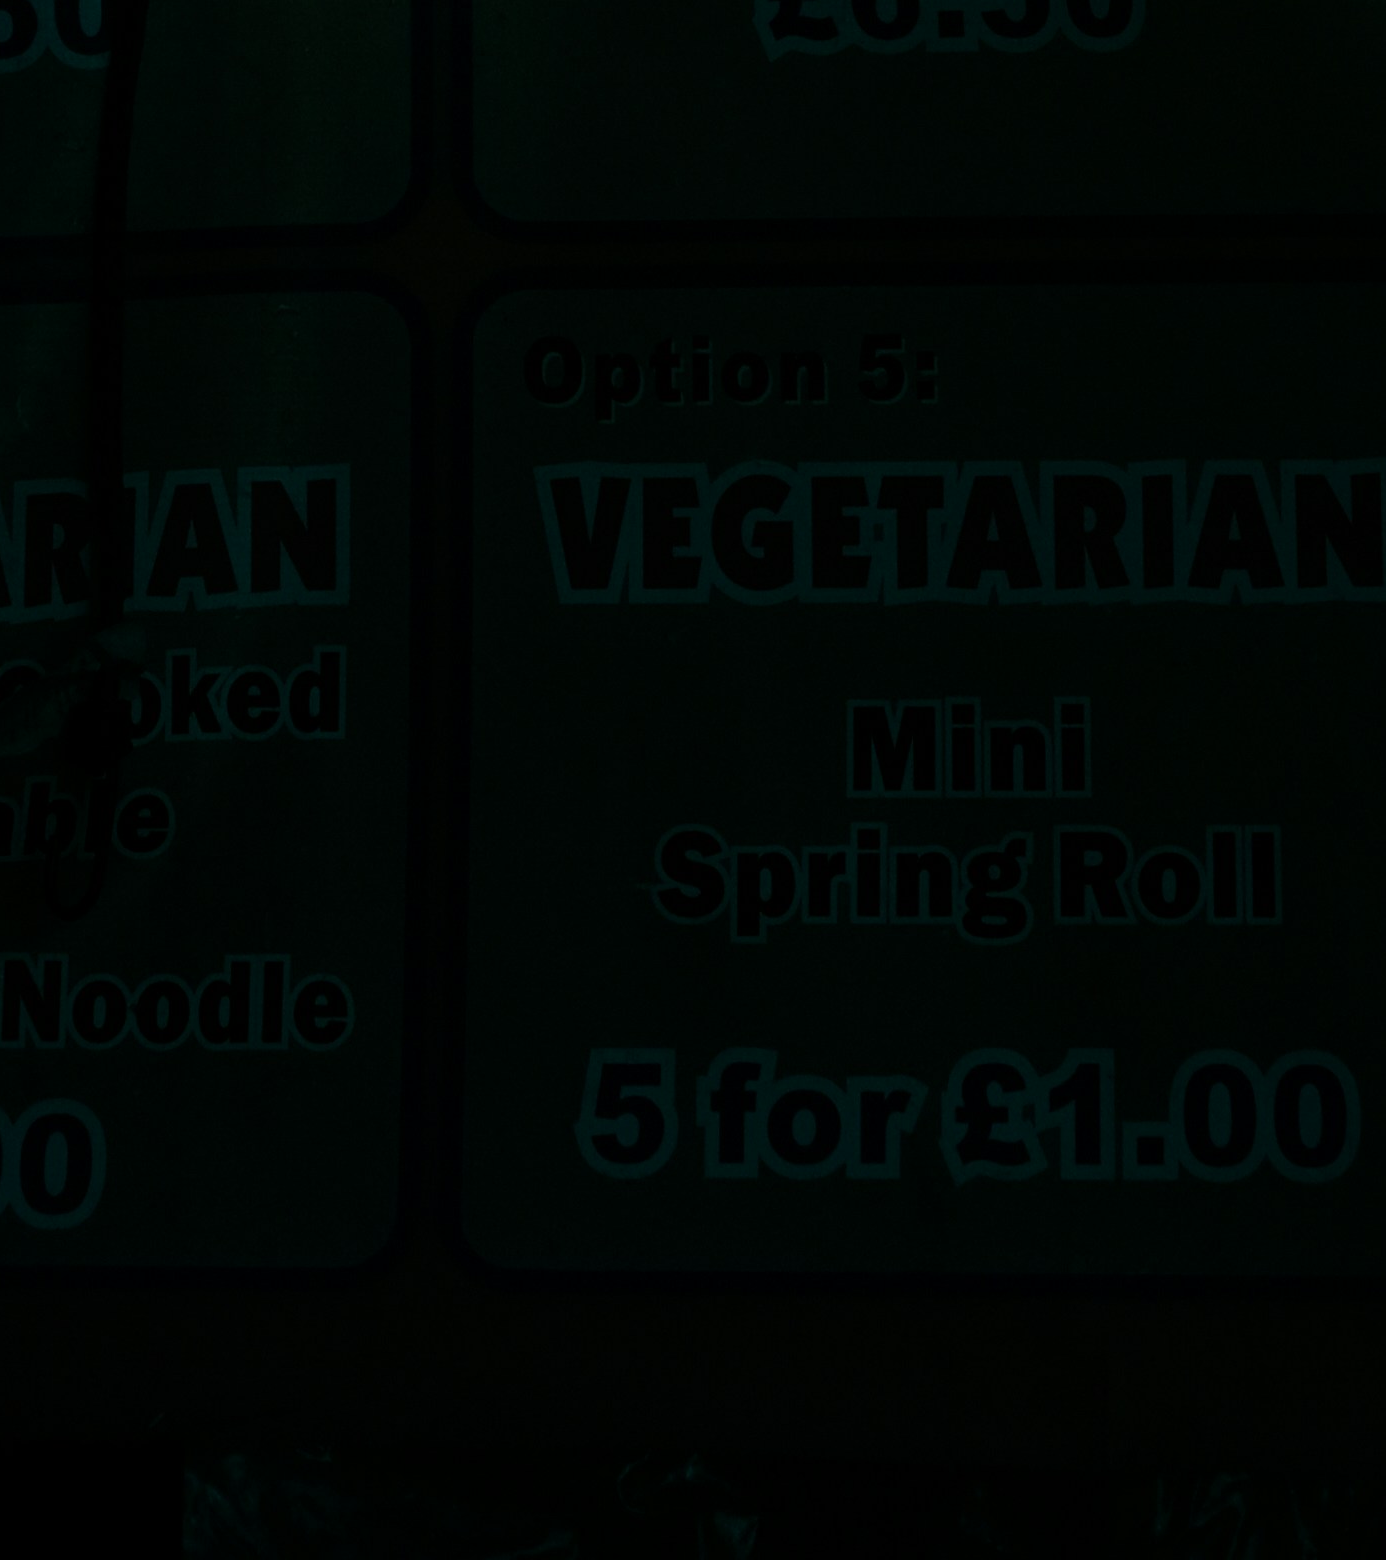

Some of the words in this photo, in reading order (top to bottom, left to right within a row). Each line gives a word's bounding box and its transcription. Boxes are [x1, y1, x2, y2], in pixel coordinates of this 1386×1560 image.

[521, 332, 830, 424] Option
[856, 331, 941, 406] 5:
[849, 700, 1089, 795] Mini
[652, 823, 1031, 942] Spring
[1054, 825, 1282, 923] Roll
[582, 1056, 671, 1170] 5
[699, 1054, 919, 1170] for
[948, 1056, 1354, 1173] £1.00
